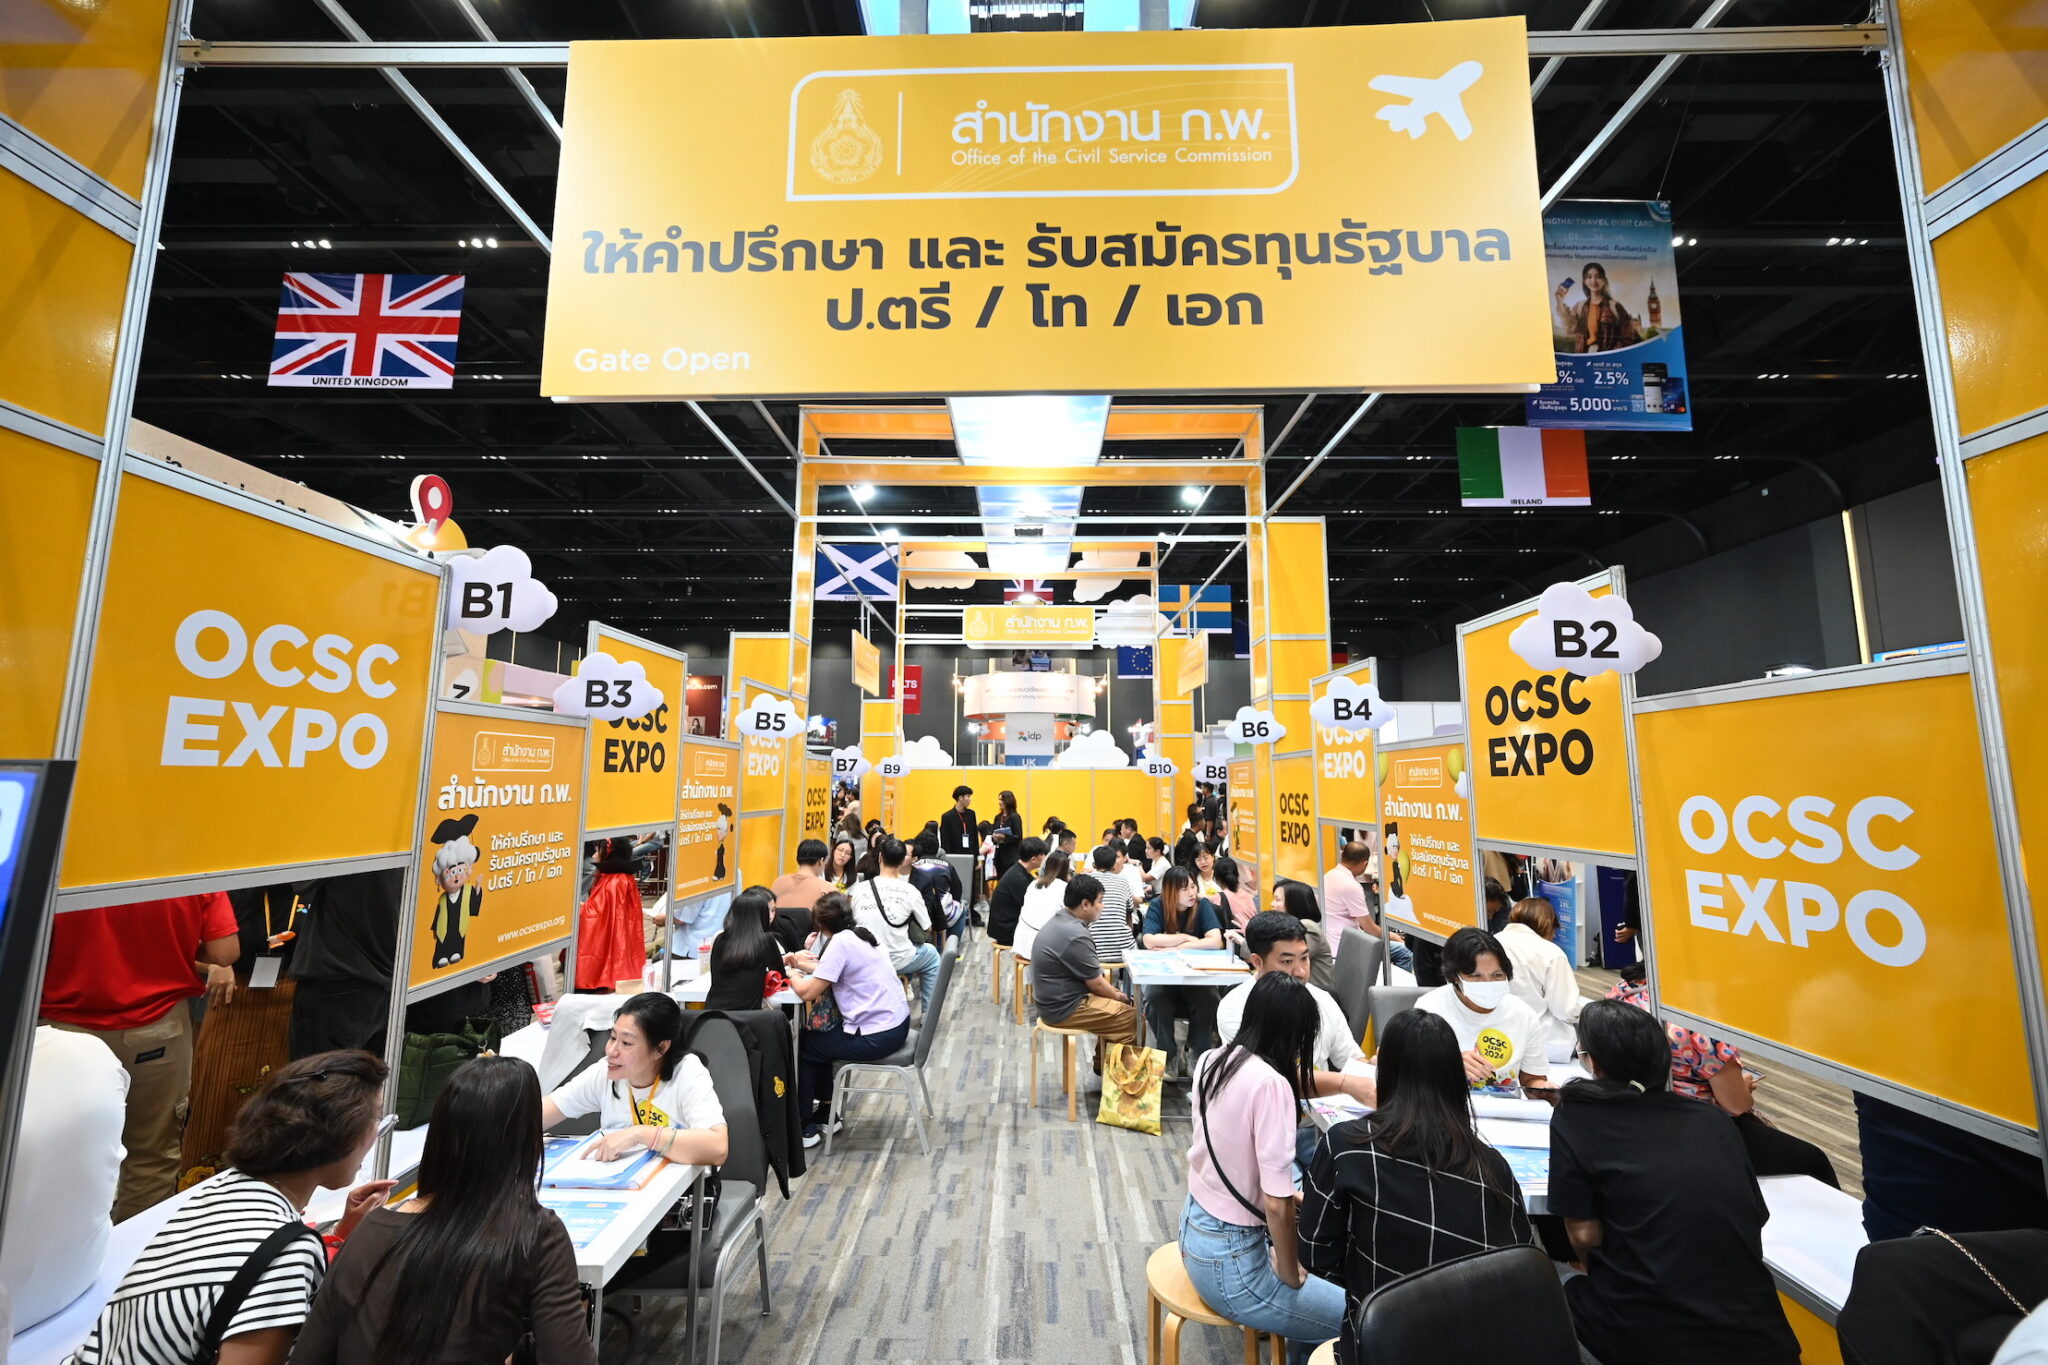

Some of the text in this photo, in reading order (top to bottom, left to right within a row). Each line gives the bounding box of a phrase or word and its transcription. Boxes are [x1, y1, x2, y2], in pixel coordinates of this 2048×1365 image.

[952, 100, 1271, 144] สำนักงาน ก.พ.
[952, 147, 1272, 166] Office of the Civil Service Commission
[1544, 217, 1575, 225] NGTHAI
[582, 218, 1512, 280] ให้คำปรึกษา และ รับสมัครทุนรัฐบาล
[826, 281, 952, 331] ป.ตรี
[1026, 283, 1087, 328] โท
[1166, 292, 1264, 326] เอก
[574, 347, 751, 375] Gate Open
[312, 377, 408, 387] UNITED KINGDOM
[1593, 371, 1629, 385] 2.5%
[461, 581, 514, 619] B1
[1553, 620, 1620, 659] B2
[174, 609, 400, 699] OCSC
[584, 680, 633, 708] B3
[891, 680, 918, 689] ITS
[1333, 698, 1373, 721] B4
[1485, 671, 1592, 726] OCSC
[160, 695, 389, 770] EXPO
[755, 712, 787, 732] B5
[1242, 721, 1270, 738] B6
[1028, 732, 1042, 742] idp
[603, 738, 666, 774] EXPO
[747, 752, 780, 777] EXPO
[836, 758, 858, 772] B7
[1022, 758, 1037, 767] UK
[1323, 750, 1366, 778] EXPO
[1488, 729, 1594, 777] EXPO
[884, 764, 901, 774] B9
[1149, 764, 1172, 774] B10
[1206, 765, 1227, 780] B8
[437, 774, 572, 810] สำนักงาน ก.พ.
[682, 778, 734, 799] สำนักงาน ก.พ.
[806, 787, 827, 807] OCSC
[1279, 792, 1310, 818] OCSC
[1384, 794, 1464, 822] สำนักงาน ก.พ.
[805, 810, 826, 831] EXPO
[491, 830, 564, 851] ให้คำปรึกษา และ
[1280, 821, 1311, 848] EXPO
[1678, 795, 1922, 871] OCSC
[1447, 841, 1460, 852] และ
[489, 847, 571, 871] รับสมัครทุนรัฐบาล
[488, 870, 513, 891] ป.ตรี
[525, 867, 536, 883] โท
[547, 865, 563, 878] เอก
[497, 915, 567, 943] www.ocscexpo.org
[1684, 869, 1927, 968] EXPO
[1483, 1036, 1507, 1048] OCSC
[1484, 1048, 1504, 1058] 2024
